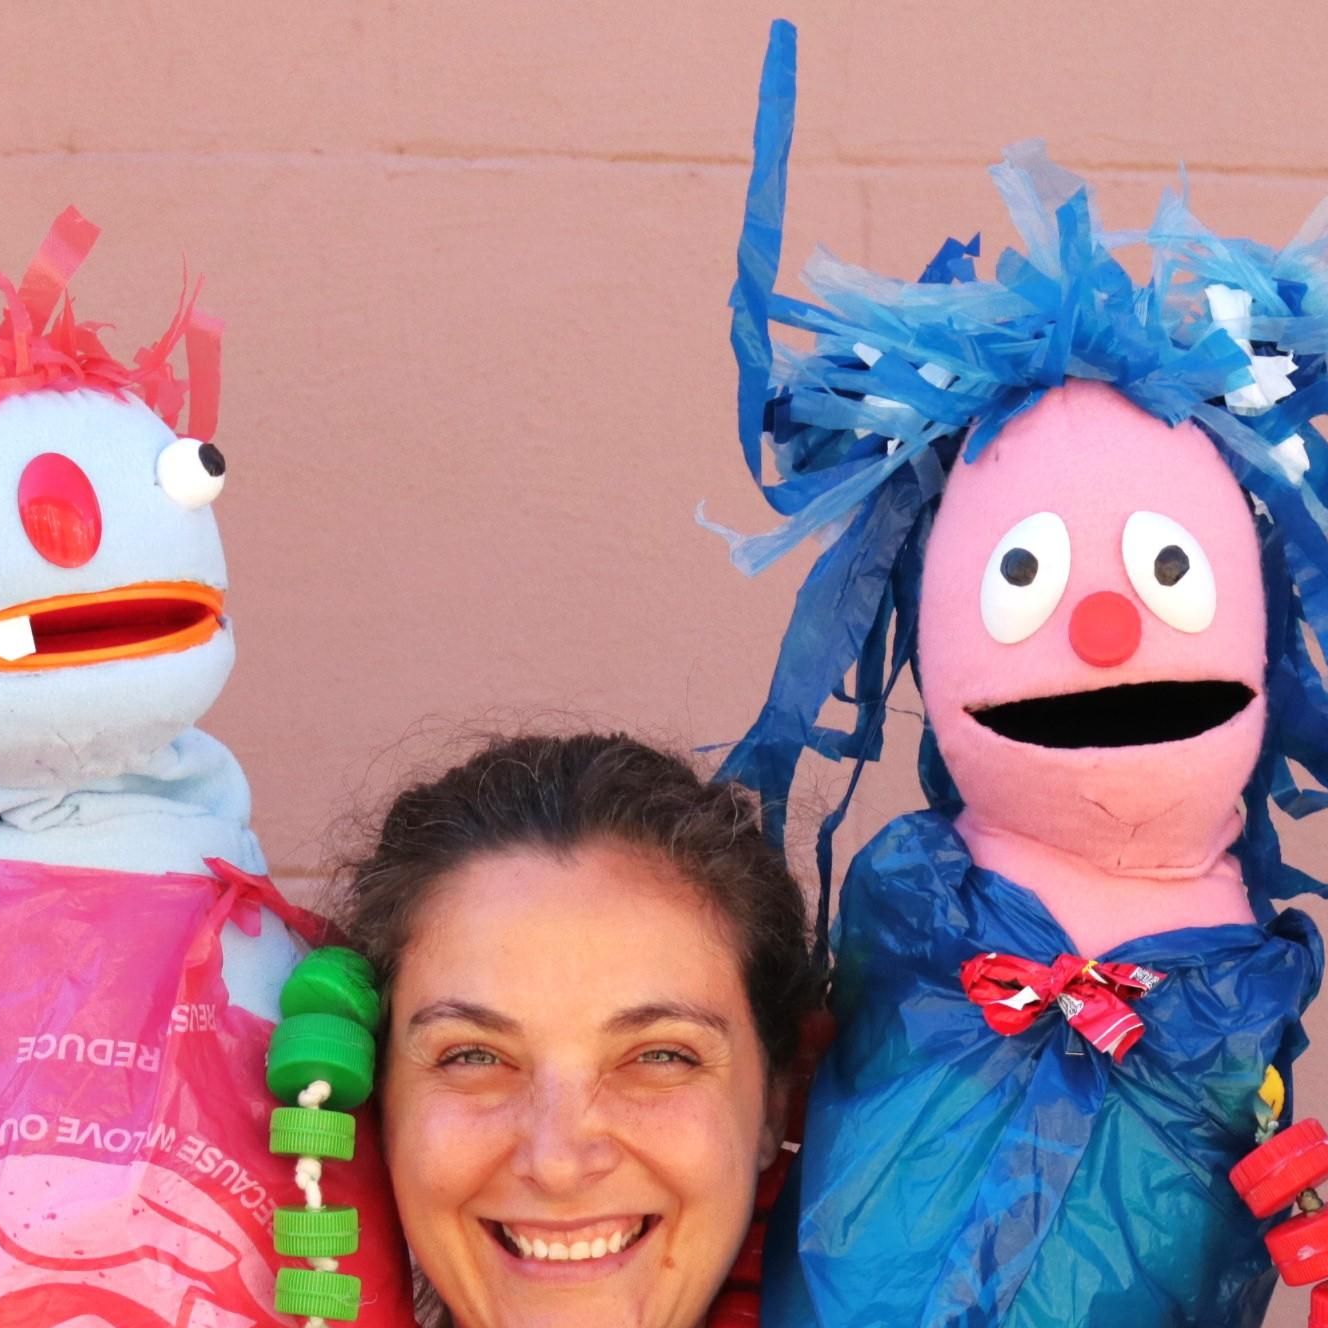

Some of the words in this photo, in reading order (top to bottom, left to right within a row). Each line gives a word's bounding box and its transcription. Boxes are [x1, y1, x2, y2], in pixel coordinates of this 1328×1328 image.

[167, 1003, 217, 1035] REUS
[16, 1033, 161, 1073] REDUCE
[55, 1116, 147, 1154] LOVE
[176, 1134, 279, 1236] ECAUSE
